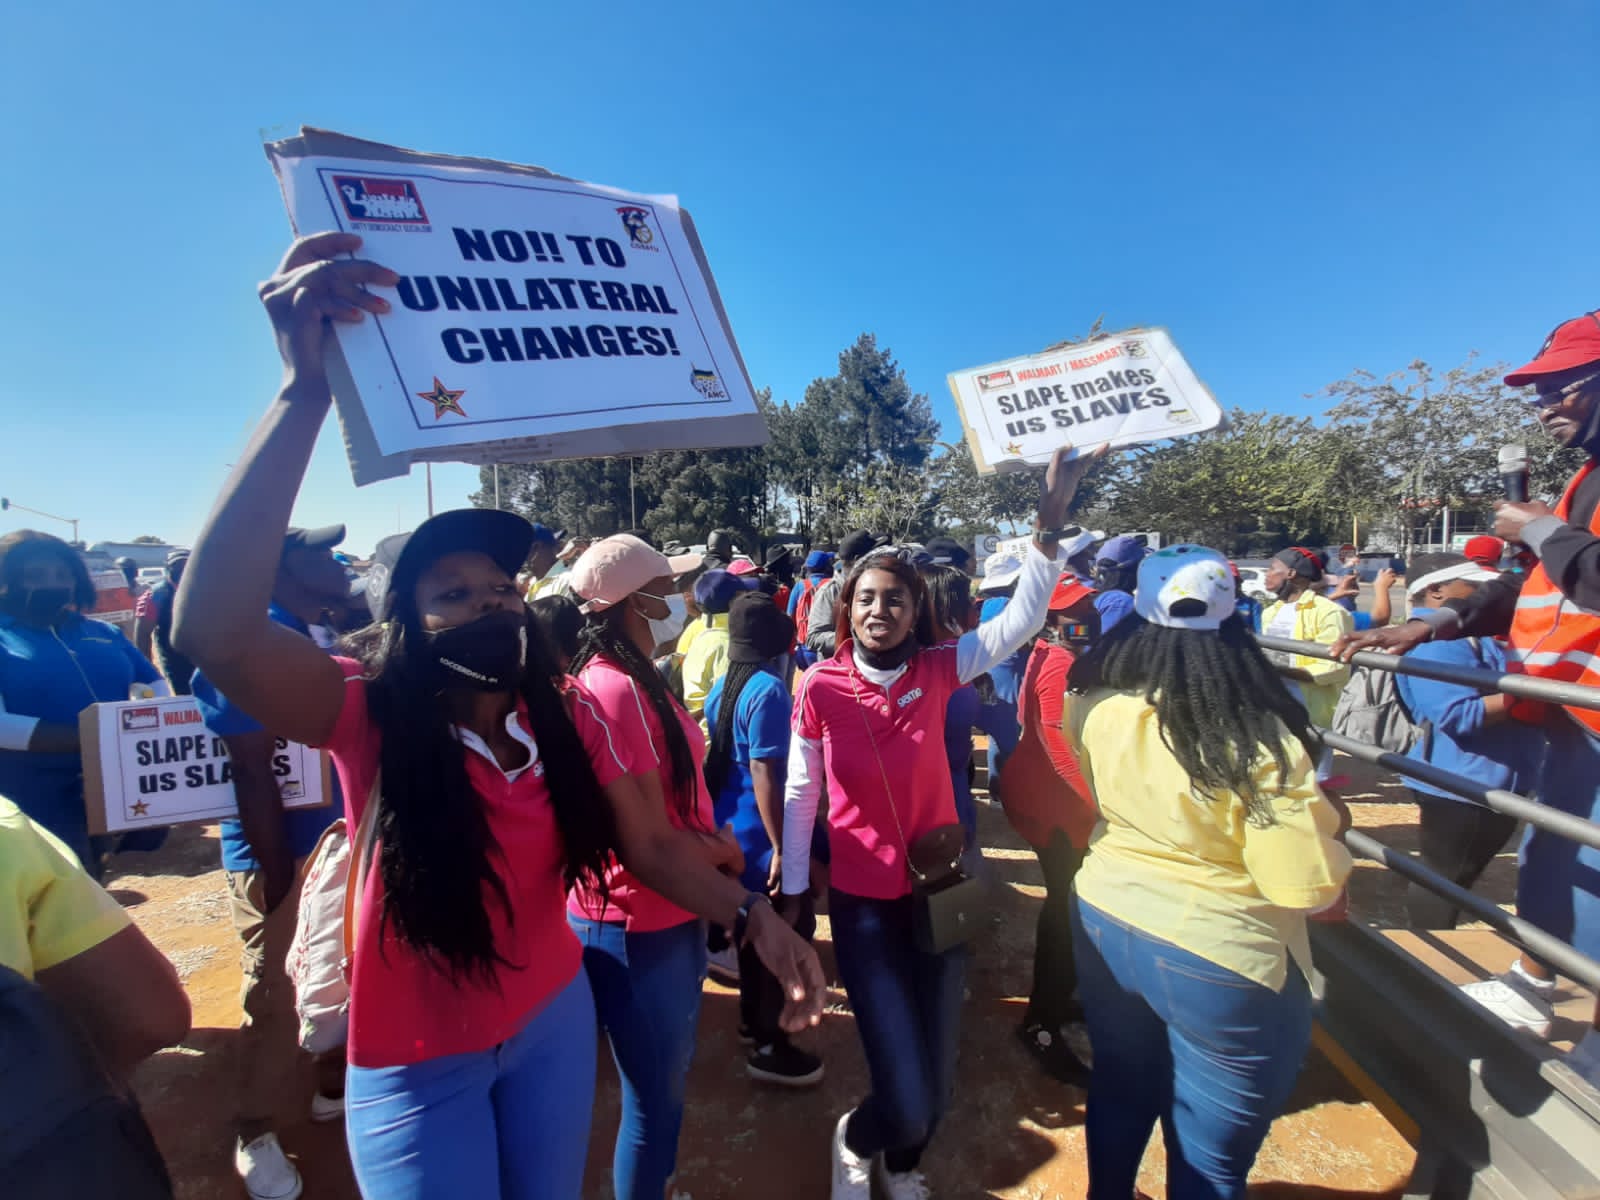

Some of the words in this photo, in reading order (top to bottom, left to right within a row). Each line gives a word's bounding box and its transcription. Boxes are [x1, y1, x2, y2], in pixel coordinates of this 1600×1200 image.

[452, 227, 564, 263] NO!!
[567, 236, 626, 268] TO
[396, 276, 678, 315] UNILATERAL
[440, 325, 681, 364] CHANGES!
[1016, 363, 1062, 382] WALMART
[1070, 344, 1123, 370] MASSMART
[997, 383, 1068, 415] SLAPE
[1071, 367, 1156, 400] makes
[1005, 416, 1047, 438] us
[1051, 386, 1172, 429] SLAVES
[163, 710, 203, 726] WALMA
[136, 734, 205, 767] SLAPE
[138, 771, 177, 794] us
